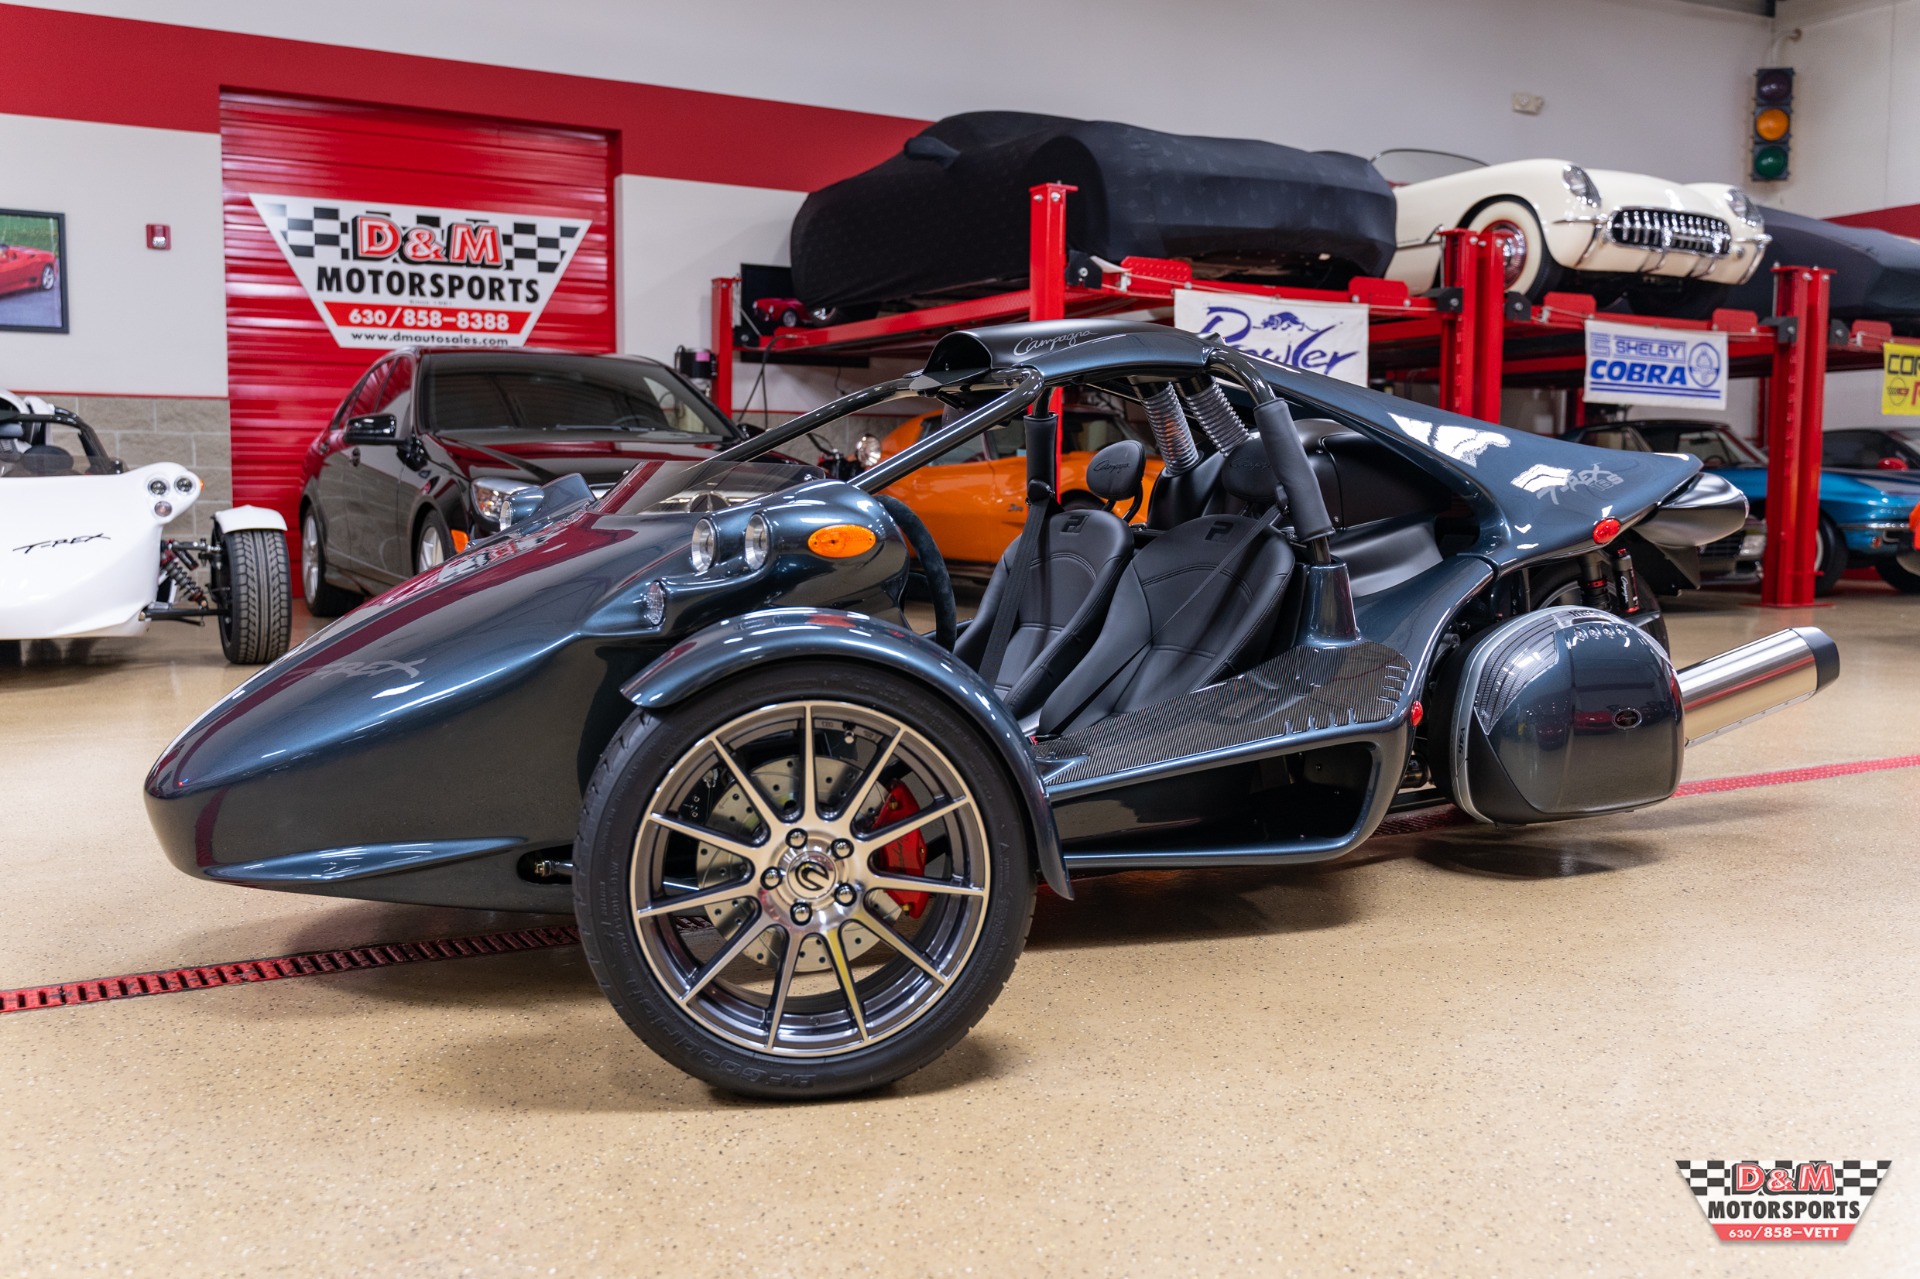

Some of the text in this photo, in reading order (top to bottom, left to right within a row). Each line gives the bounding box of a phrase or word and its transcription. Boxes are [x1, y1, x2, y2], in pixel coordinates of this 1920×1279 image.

[352, 214, 505, 269] D&M
[316, 266, 540, 303] MOTORSPORTS
[349, 306, 510, 331] 630/858-8388
[350, 330, 509, 347] www.dmautosales.com
[1013, 330, 1099, 356] Campagna
[1615, 340, 1680, 358] SHELBY
[1590, 359, 1687, 385] COBRA
[12, 532, 111, 554] T-REX
